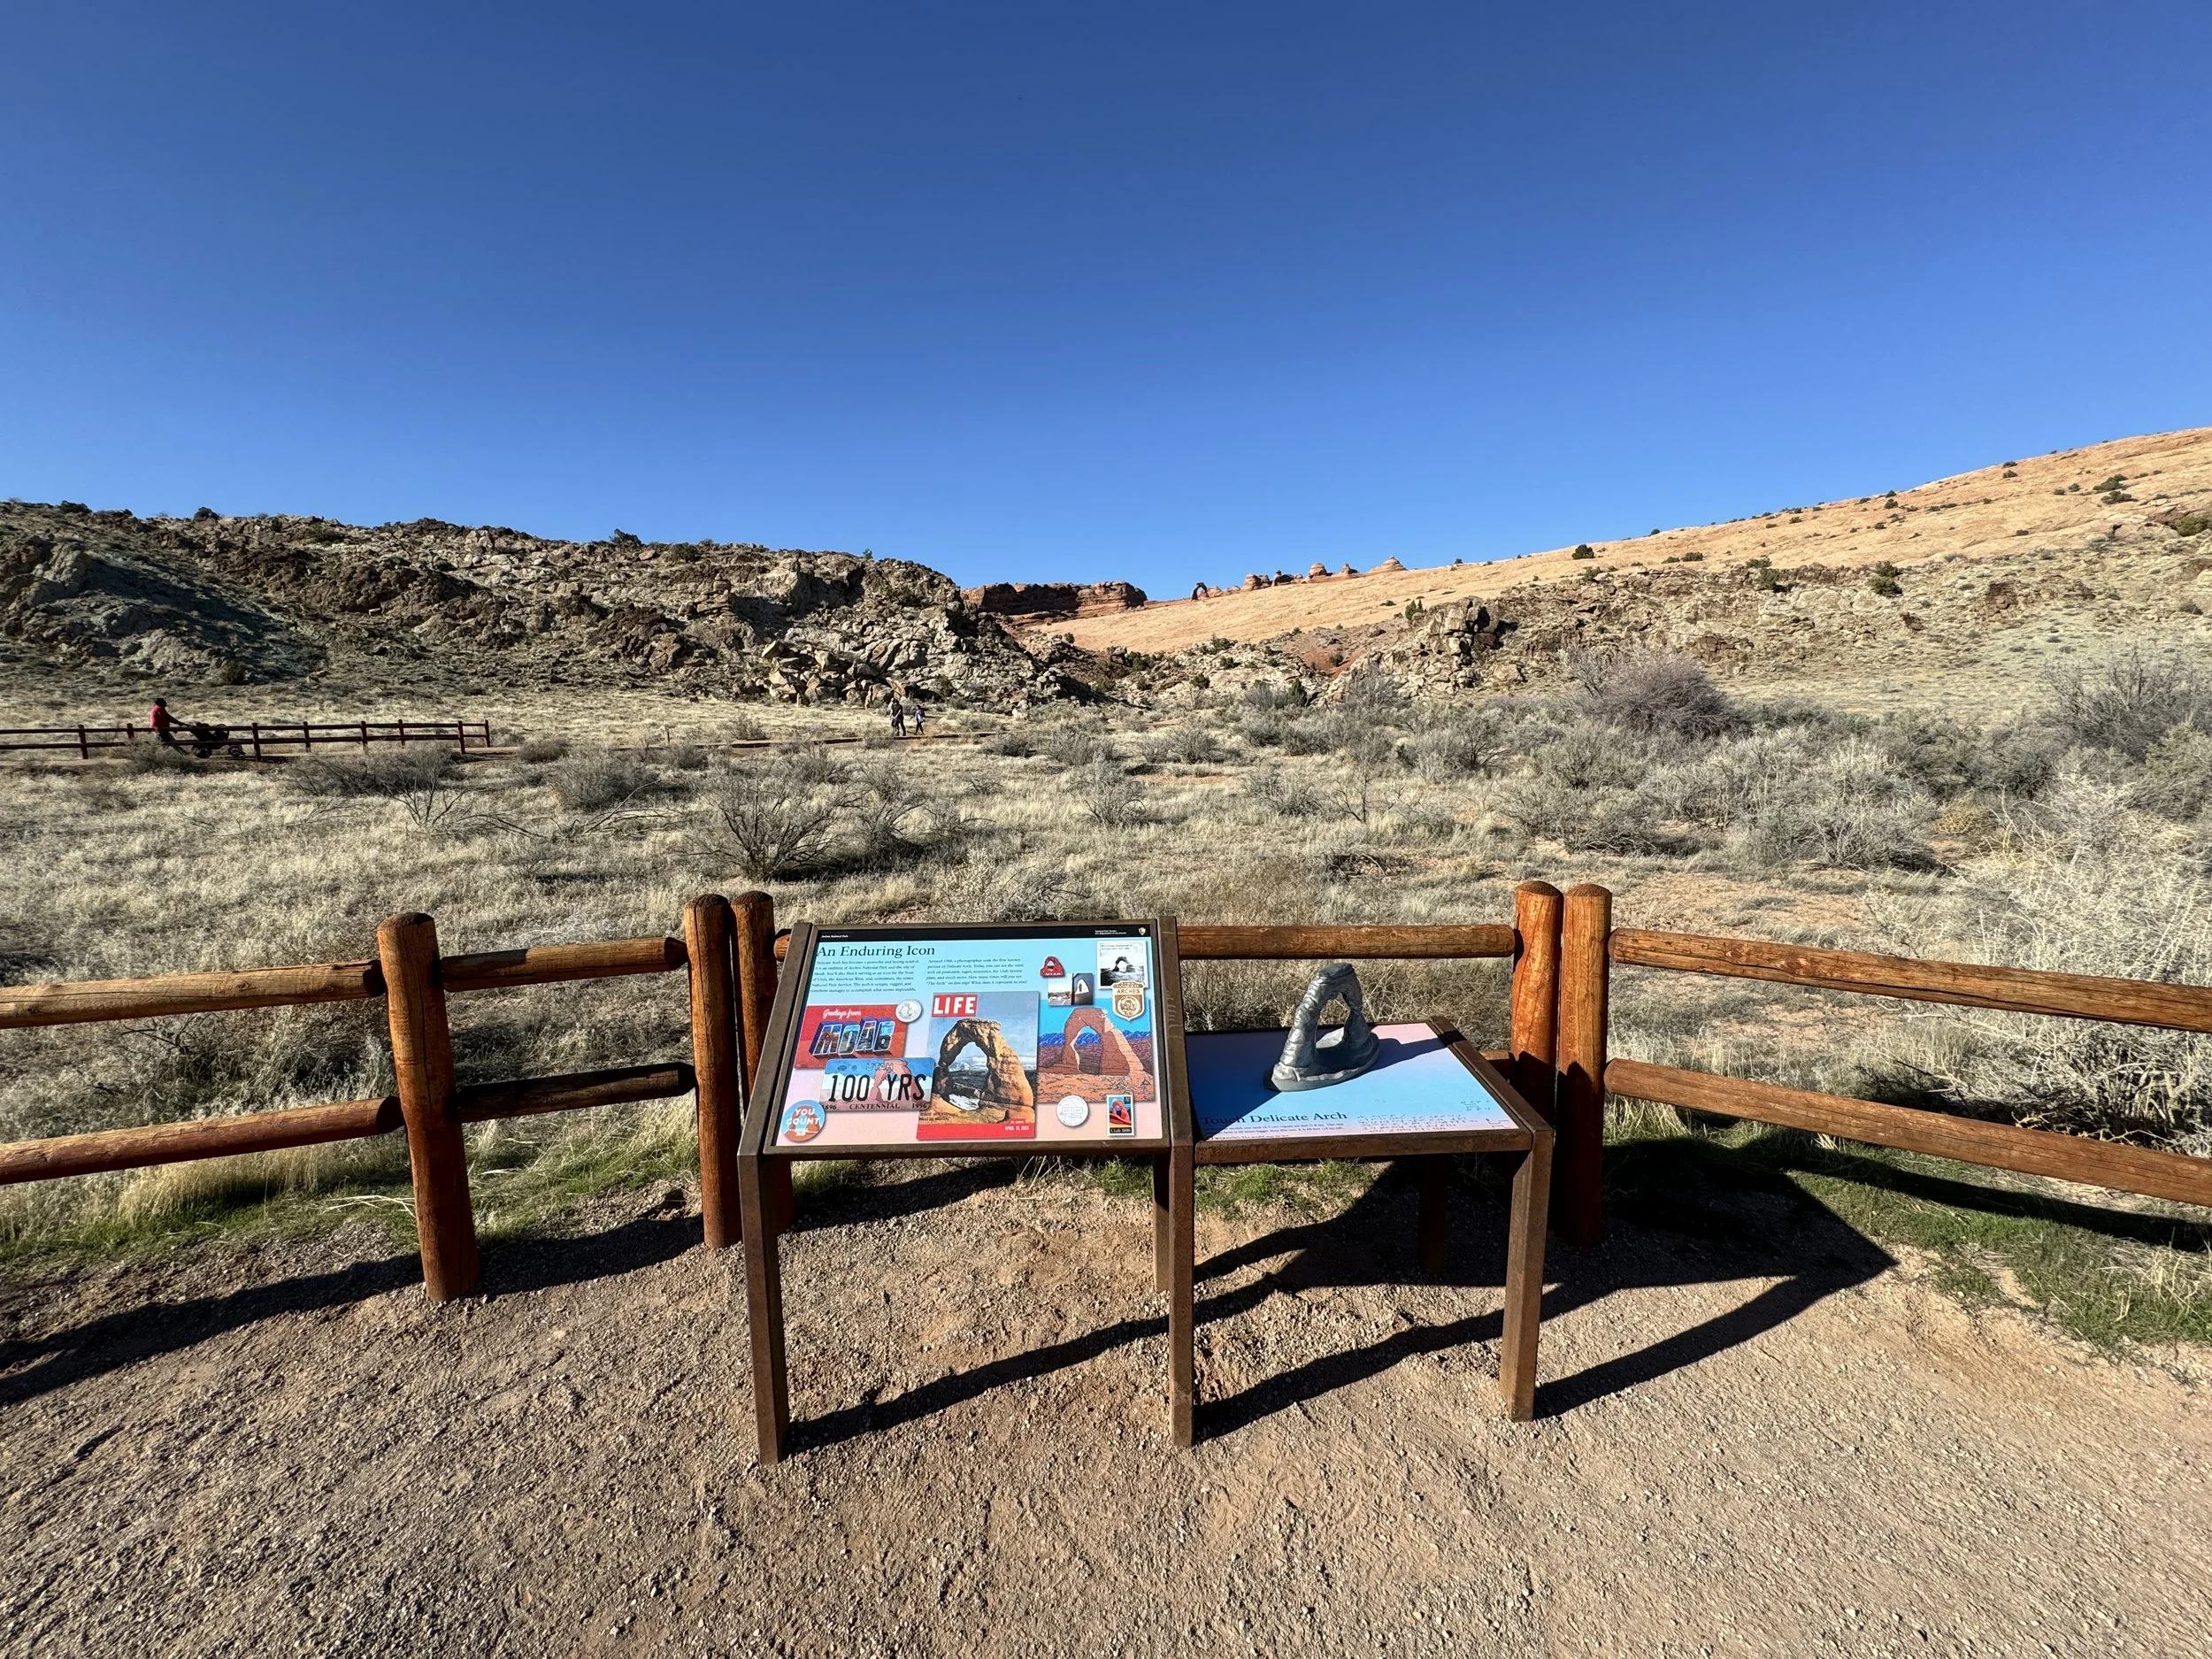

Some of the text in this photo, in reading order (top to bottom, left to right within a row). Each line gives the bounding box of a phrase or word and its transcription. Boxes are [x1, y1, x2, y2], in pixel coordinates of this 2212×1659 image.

[817, 945, 935, 958] An Enduring Icon
[823, 1008, 862, 1018] Greetings from
[933, 996, 977, 1015] LIFE
[809, 1018, 896, 1056] MOAB
[828, 1073, 926, 1102] 100 YRS
[1200, 1115, 1246, 1124] Touch
[1248, 1114, 1309, 1123] Delicate
[1313, 1111, 1348, 1120] Arch
